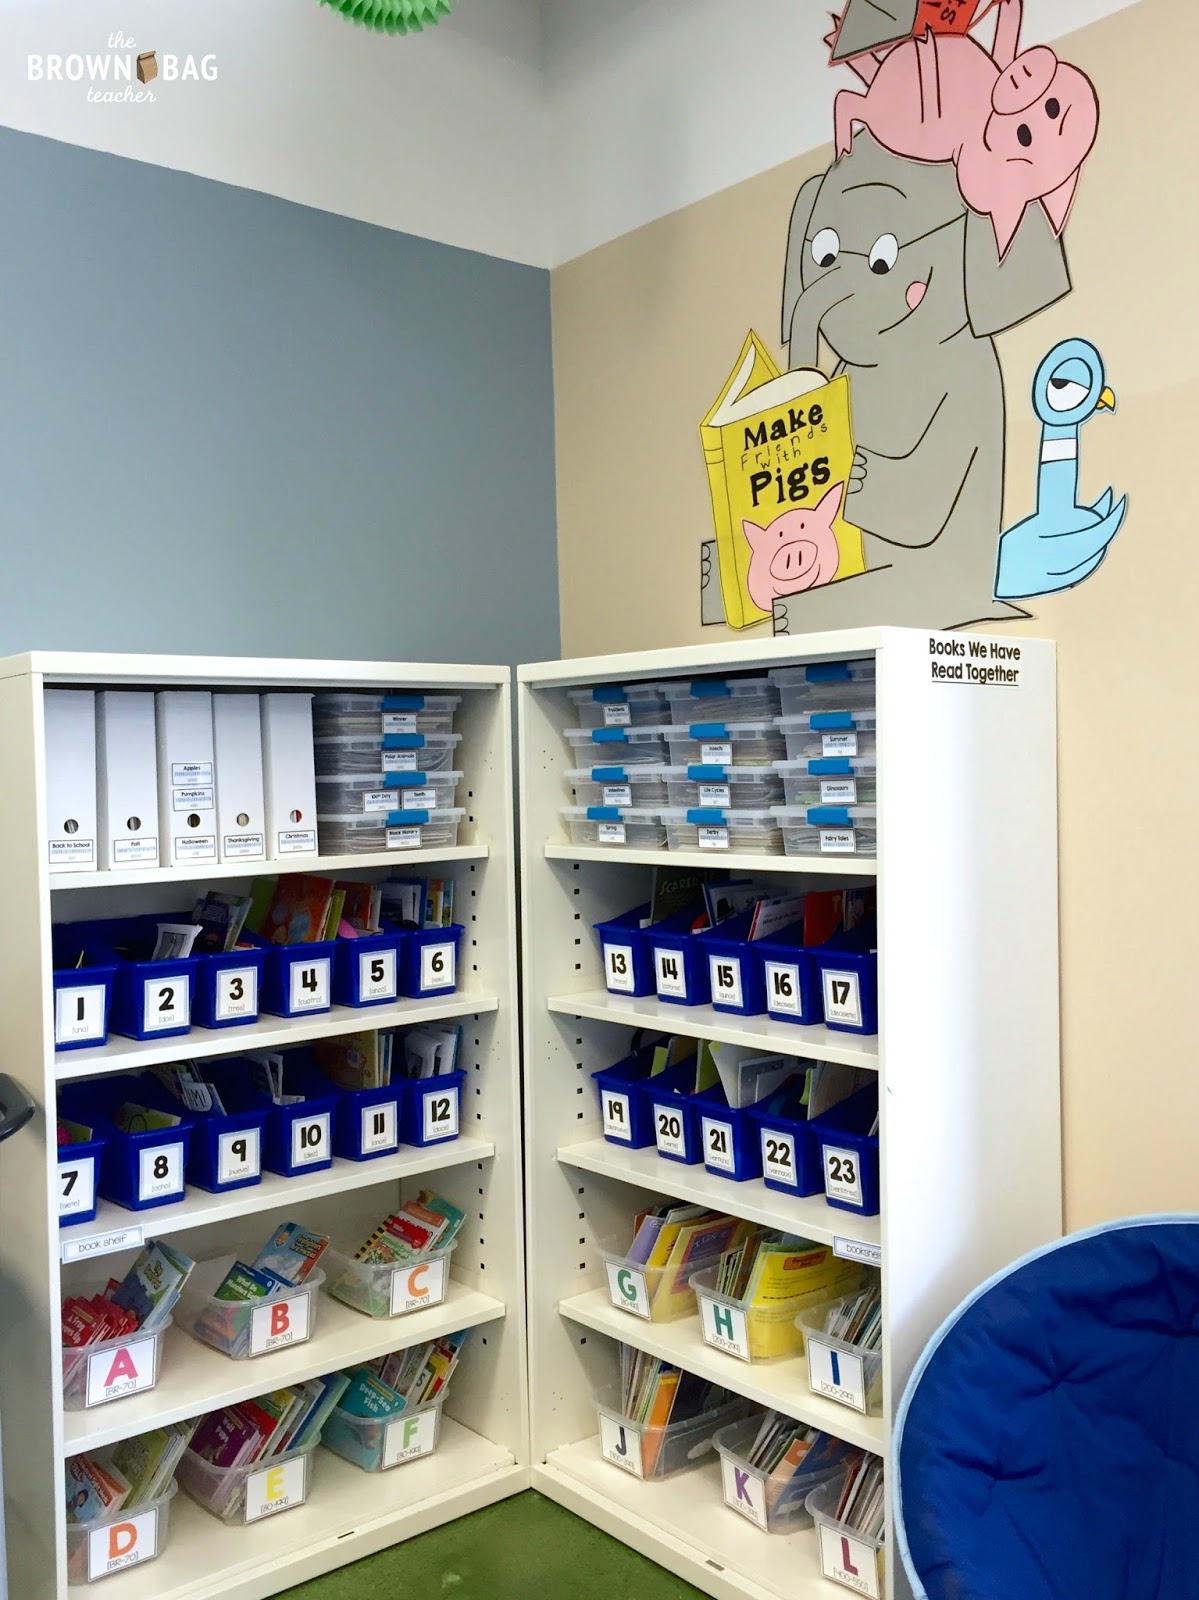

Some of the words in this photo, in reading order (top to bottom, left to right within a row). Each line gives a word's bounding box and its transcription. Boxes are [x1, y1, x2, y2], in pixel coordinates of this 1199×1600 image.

[743, 404, 823, 451] Make
[761, 447, 801, 470] with
[750, 456, 831, 507] Pigs
[929, 638, 965, 657] Books
[969, 641, 987, 658] We
[990, 642, 1021, 660] Have
[931, 661, 963, 679] Read
[966, 663, 1019, 684] Together
[183, 765, 201, 773] Apples
[181, 790, 205, 798] Pumpkins
[371, 959, 384, 982] 5
[431, 952, 444, 972] 6
[611, 953, 627, 974] 13
[661, 957, 678, 980] 14
[229, 977, 244, 1000] 3
[302, 968, 318, 992] 4
[717, 965, 734, 988] 15
[774, 972, 792, 996] 16
[158, 987, 174, 1011] 2
[831, 981, 850, 1005] 17
[77, 997, 84, 1021] 1
[72, 1026, 88, 1035] [uno]
[431, 1098, 450, 1123] 12
[608, 1100, 624, 1123] 19
[373, 1112, 385, 1135] 11
[658, 1114, 680, 1139] 20
[301, 1124, 321, 1148] 10
[710, 1129, 727, 1153] 21
[231, 1139, 246, 1161] 9
[766, 1139, 791, 1167] 22
[153, 1155, 168, 1179] 8
[829, 1156, 856, 1184] 23
[61, 1170, 78, 1196] 7
[151, 1182, 171, 1192] [ocho]
[78, 1239, 102, 1254] book
[104, 1234, 128, 1247] shelf
[408, 1264, 429, 1297] C
[618, 1269, 637, 1301] G
[405, 1294, 430, 1309] [BR-70]
[271, 1302, 290, 1337] B
[713, 1304, 734, 1340] H
[265, 1332, 293, 1348] [BR-70]
[104, 1348, 139, 1387] A
[106, 1379, 137, 1397] [BR-70]
[403, 1417, 419, 1449] F
[615, 1426, 626, 1456] J
[265, 1466, 285, 1501] E
[734, 1467, 753, 1507] K
[109, 1522, 138, 1559] D
[107, 1551, 138, 1570] [BR-70]
[841, 1536, 858, 1576] L
